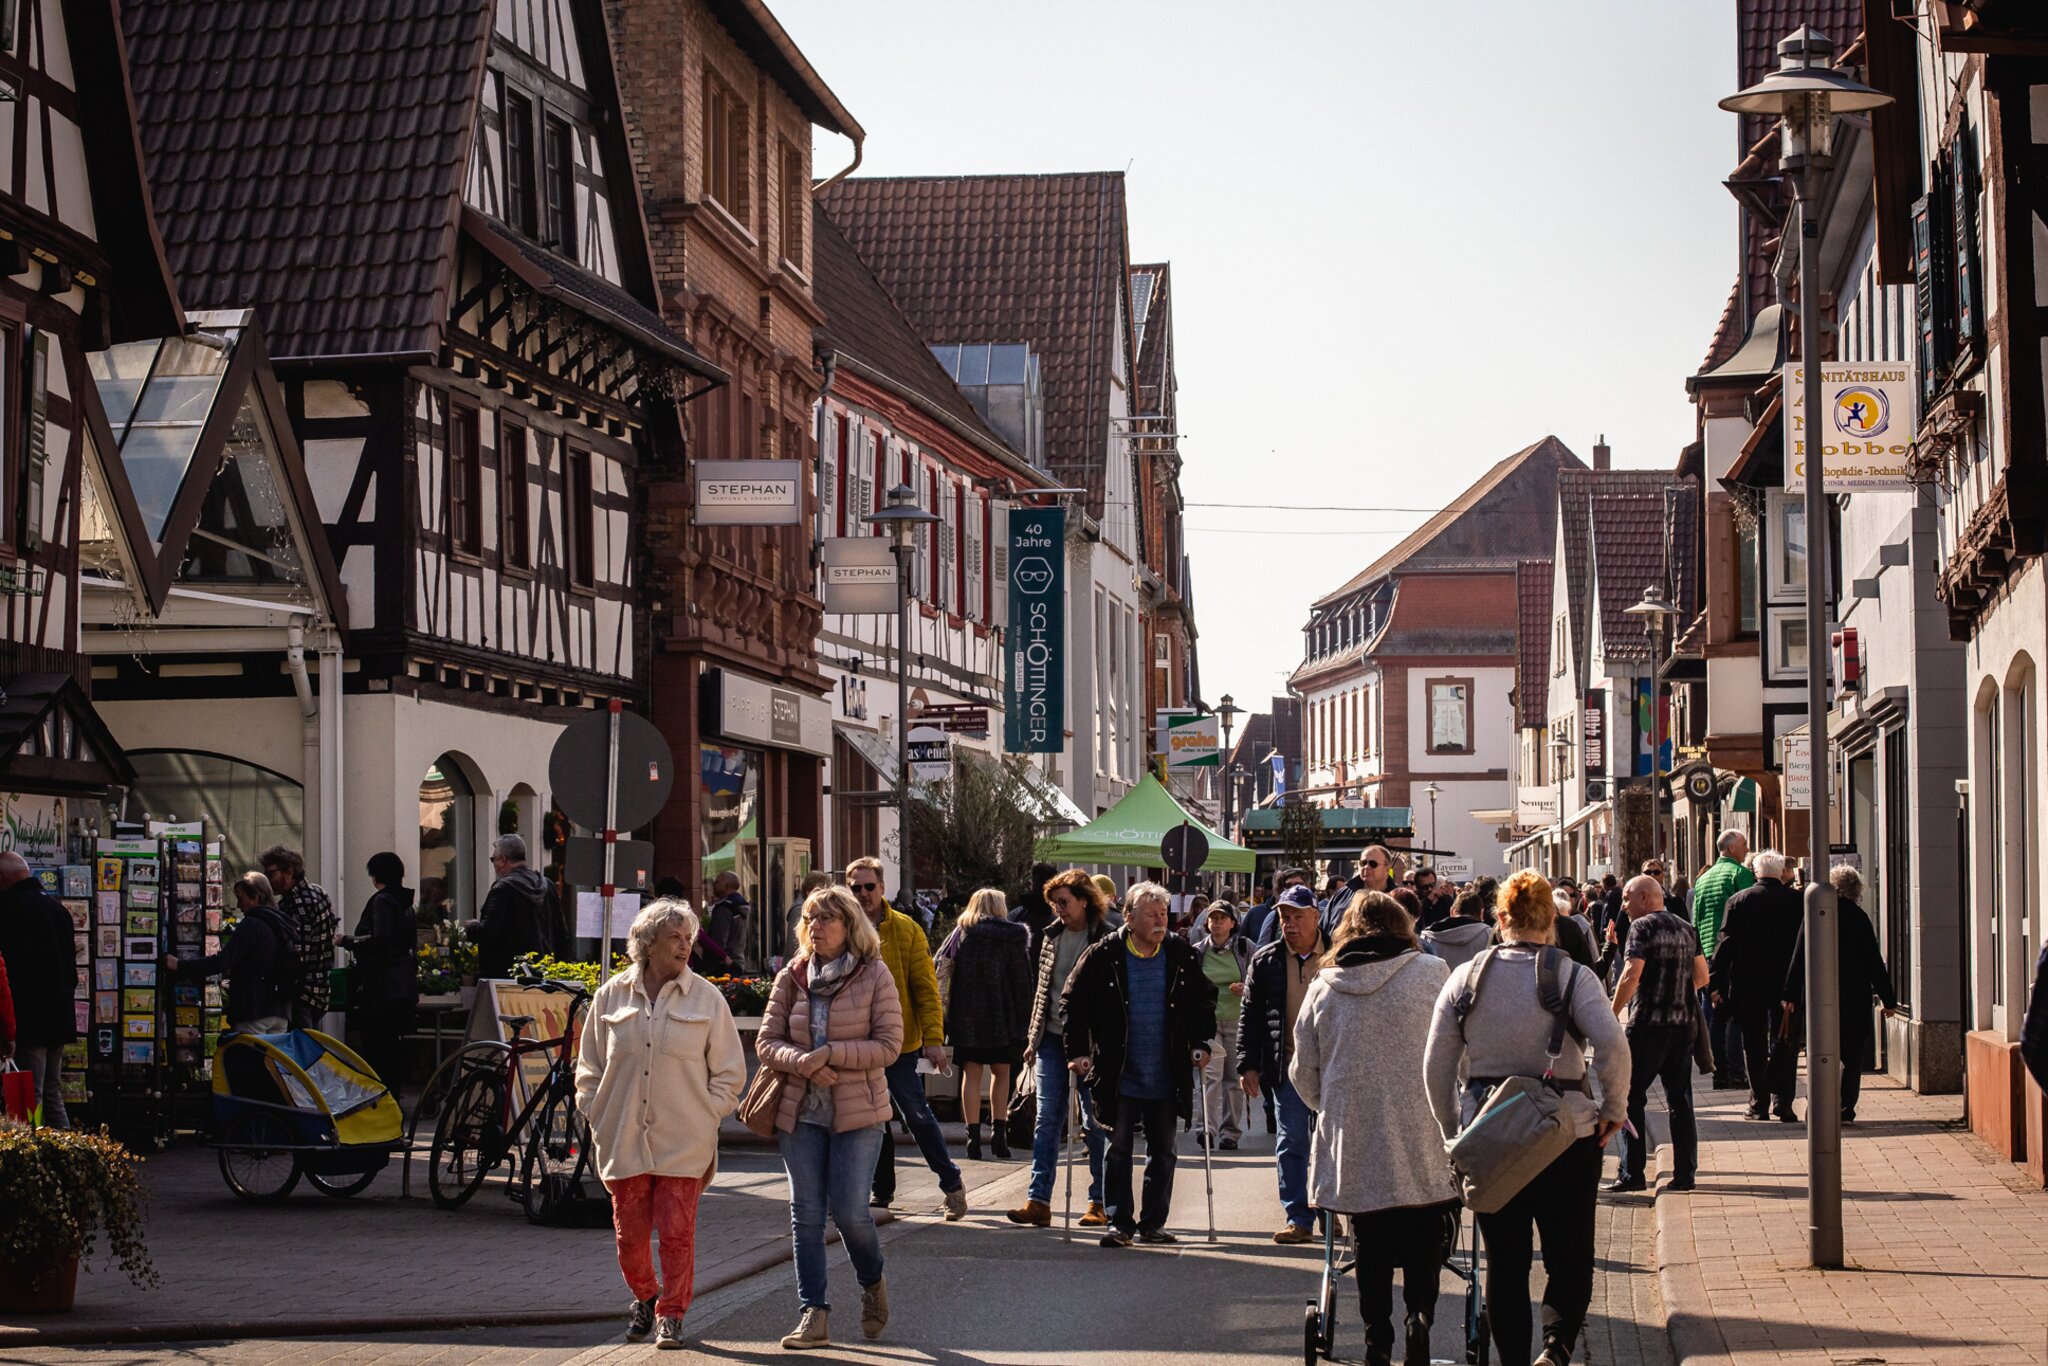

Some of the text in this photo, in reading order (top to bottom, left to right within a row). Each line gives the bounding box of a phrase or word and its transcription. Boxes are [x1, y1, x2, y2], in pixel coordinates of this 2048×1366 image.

[1795, 369, 1906, 385] SNITÄTSHAUS
[708, 484, 787, 495] STEPHAN
[1025, 524, 1043, 535] 40
[1015, 537, 1052, 547] Jahre
[833, 568, 891, 577] STEPHAN
[1026, 602, 1053, 743] SCHÖTTINGER
[1170, 730, 1217, 751] grahn
[1585, 708, 1601, 767] SOKO 4400
[1520, 799, 1555, 811] Sempre
